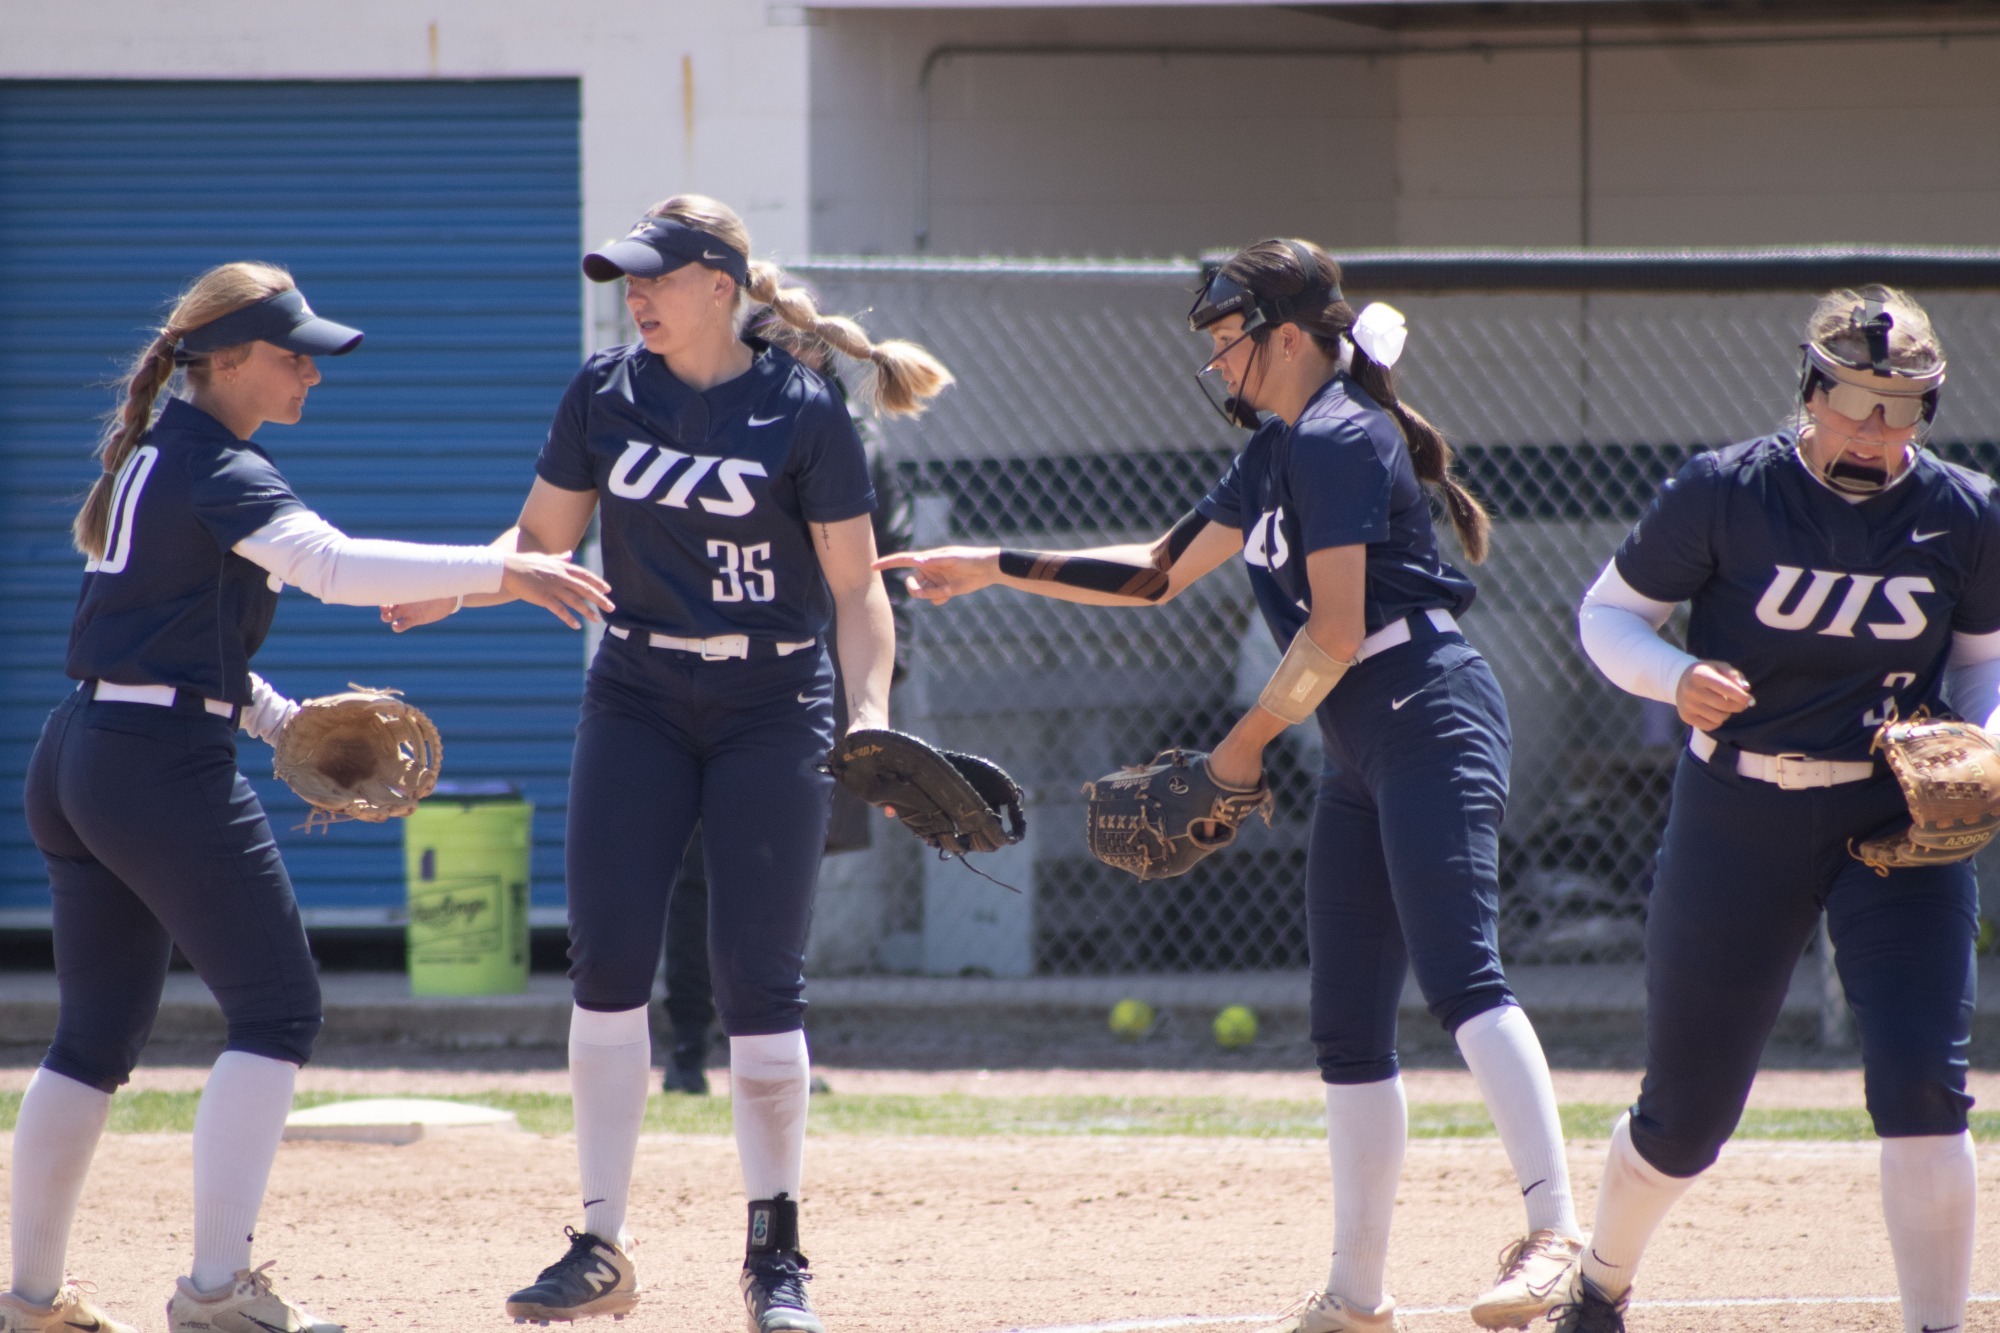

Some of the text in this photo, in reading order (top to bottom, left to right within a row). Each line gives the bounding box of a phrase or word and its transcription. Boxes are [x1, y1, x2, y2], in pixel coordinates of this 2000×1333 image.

[84, 445, 158, 574] 0
[608, 440, 768, 517] UIS
[706, 539, 776, 602] 35
[1755, 564, 1936, 641] UIS
